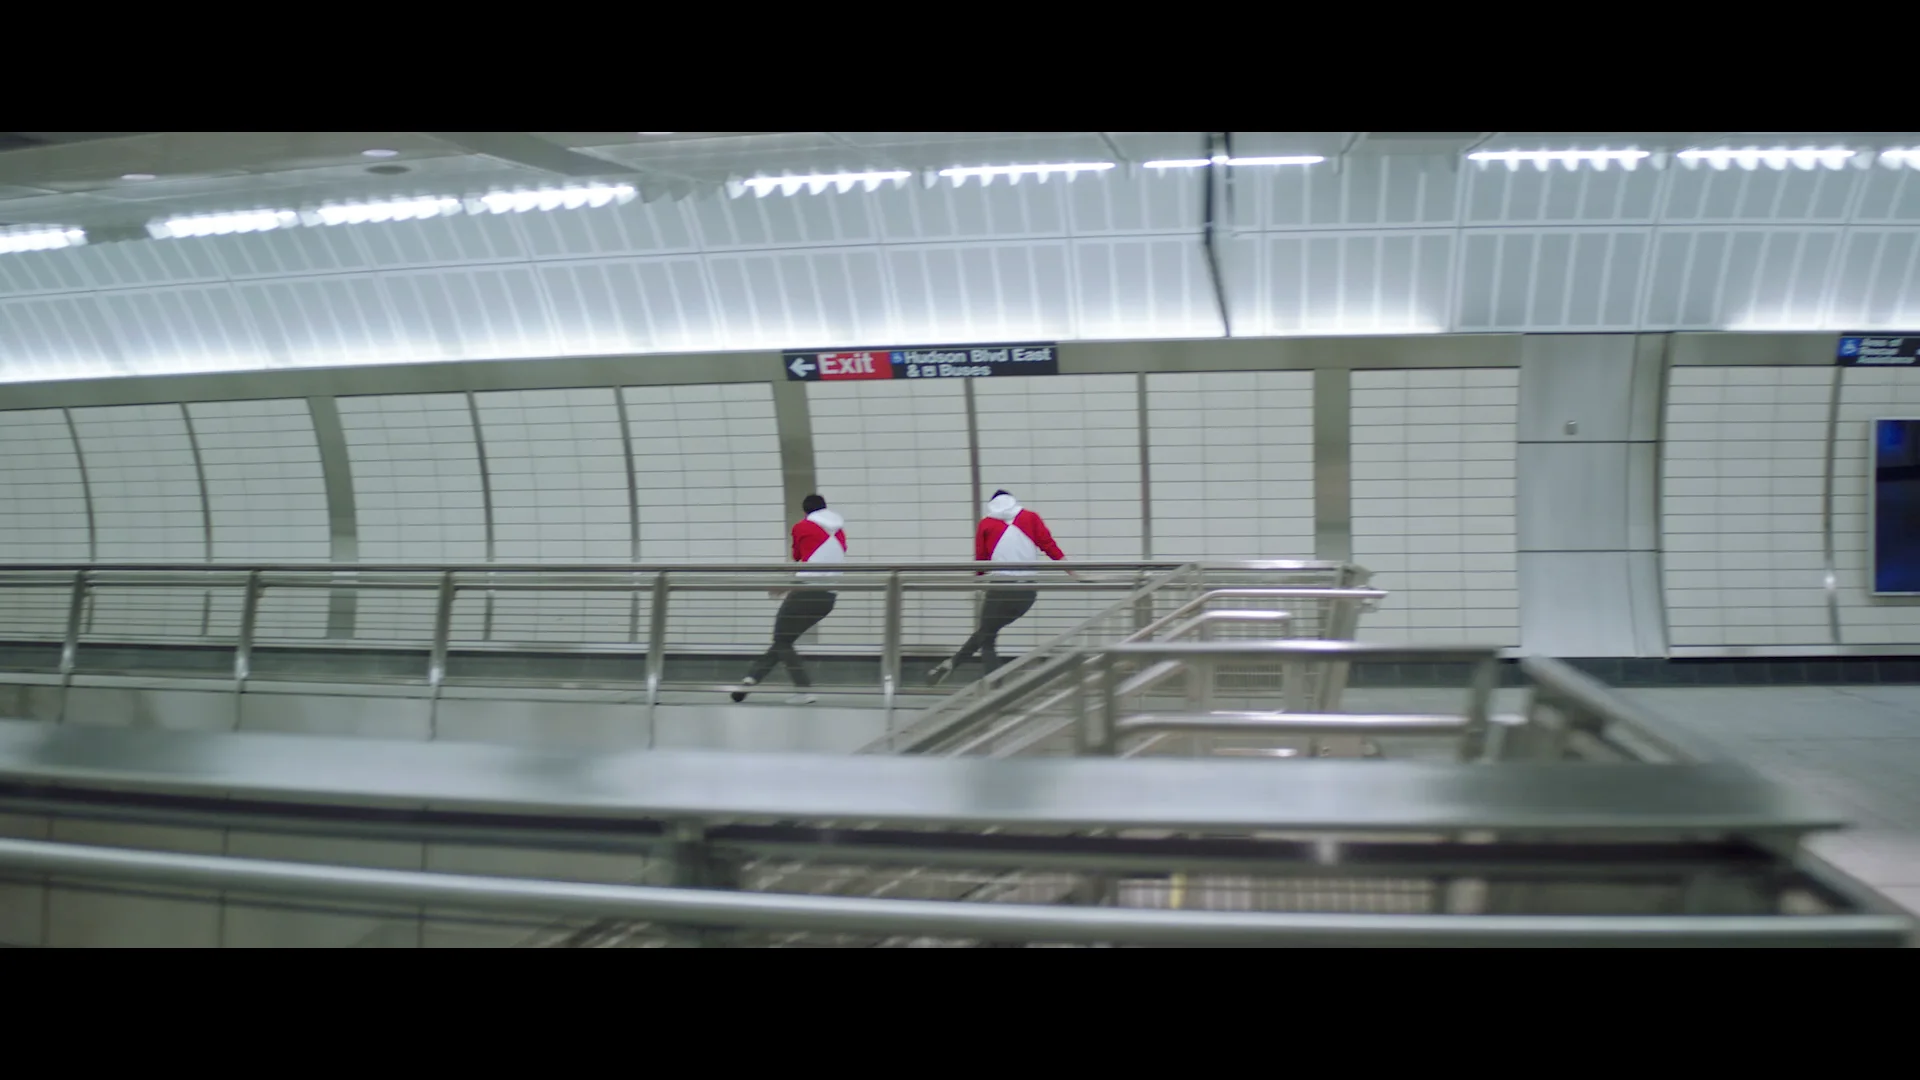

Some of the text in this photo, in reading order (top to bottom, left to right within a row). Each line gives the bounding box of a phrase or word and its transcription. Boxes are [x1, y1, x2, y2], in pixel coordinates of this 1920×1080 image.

[818, 353, 875, 374] Exit
[906, 348, 1051, 364] Hudson Blvd East
[907, 364, 991, 377] & Buses
